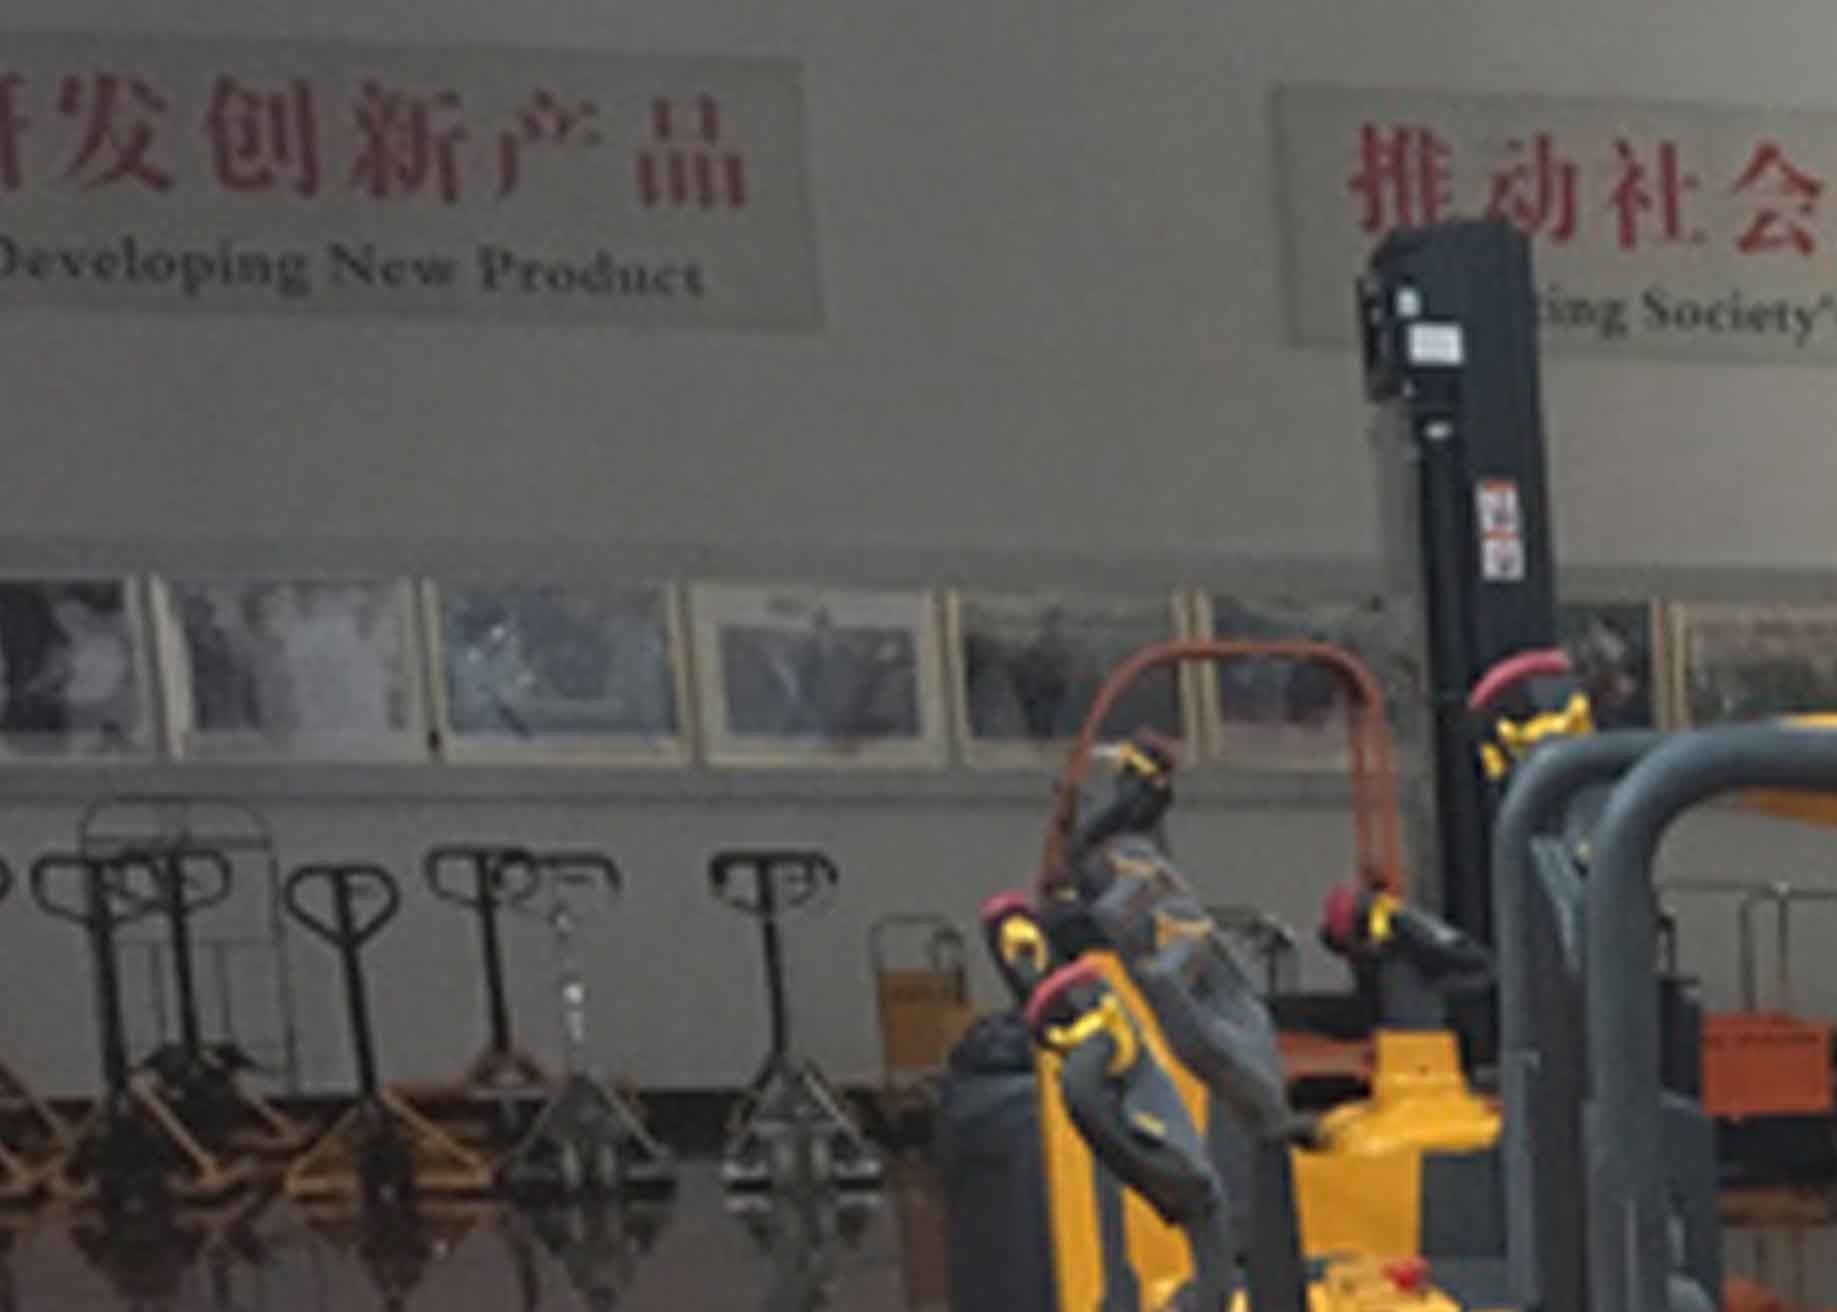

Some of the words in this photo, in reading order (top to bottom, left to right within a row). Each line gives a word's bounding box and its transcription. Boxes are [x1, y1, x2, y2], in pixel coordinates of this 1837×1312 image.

[0, 70, 747, 212] 发创新产品
[328, 243, 457, 289] New
[478, 244, 705, 298] Product
